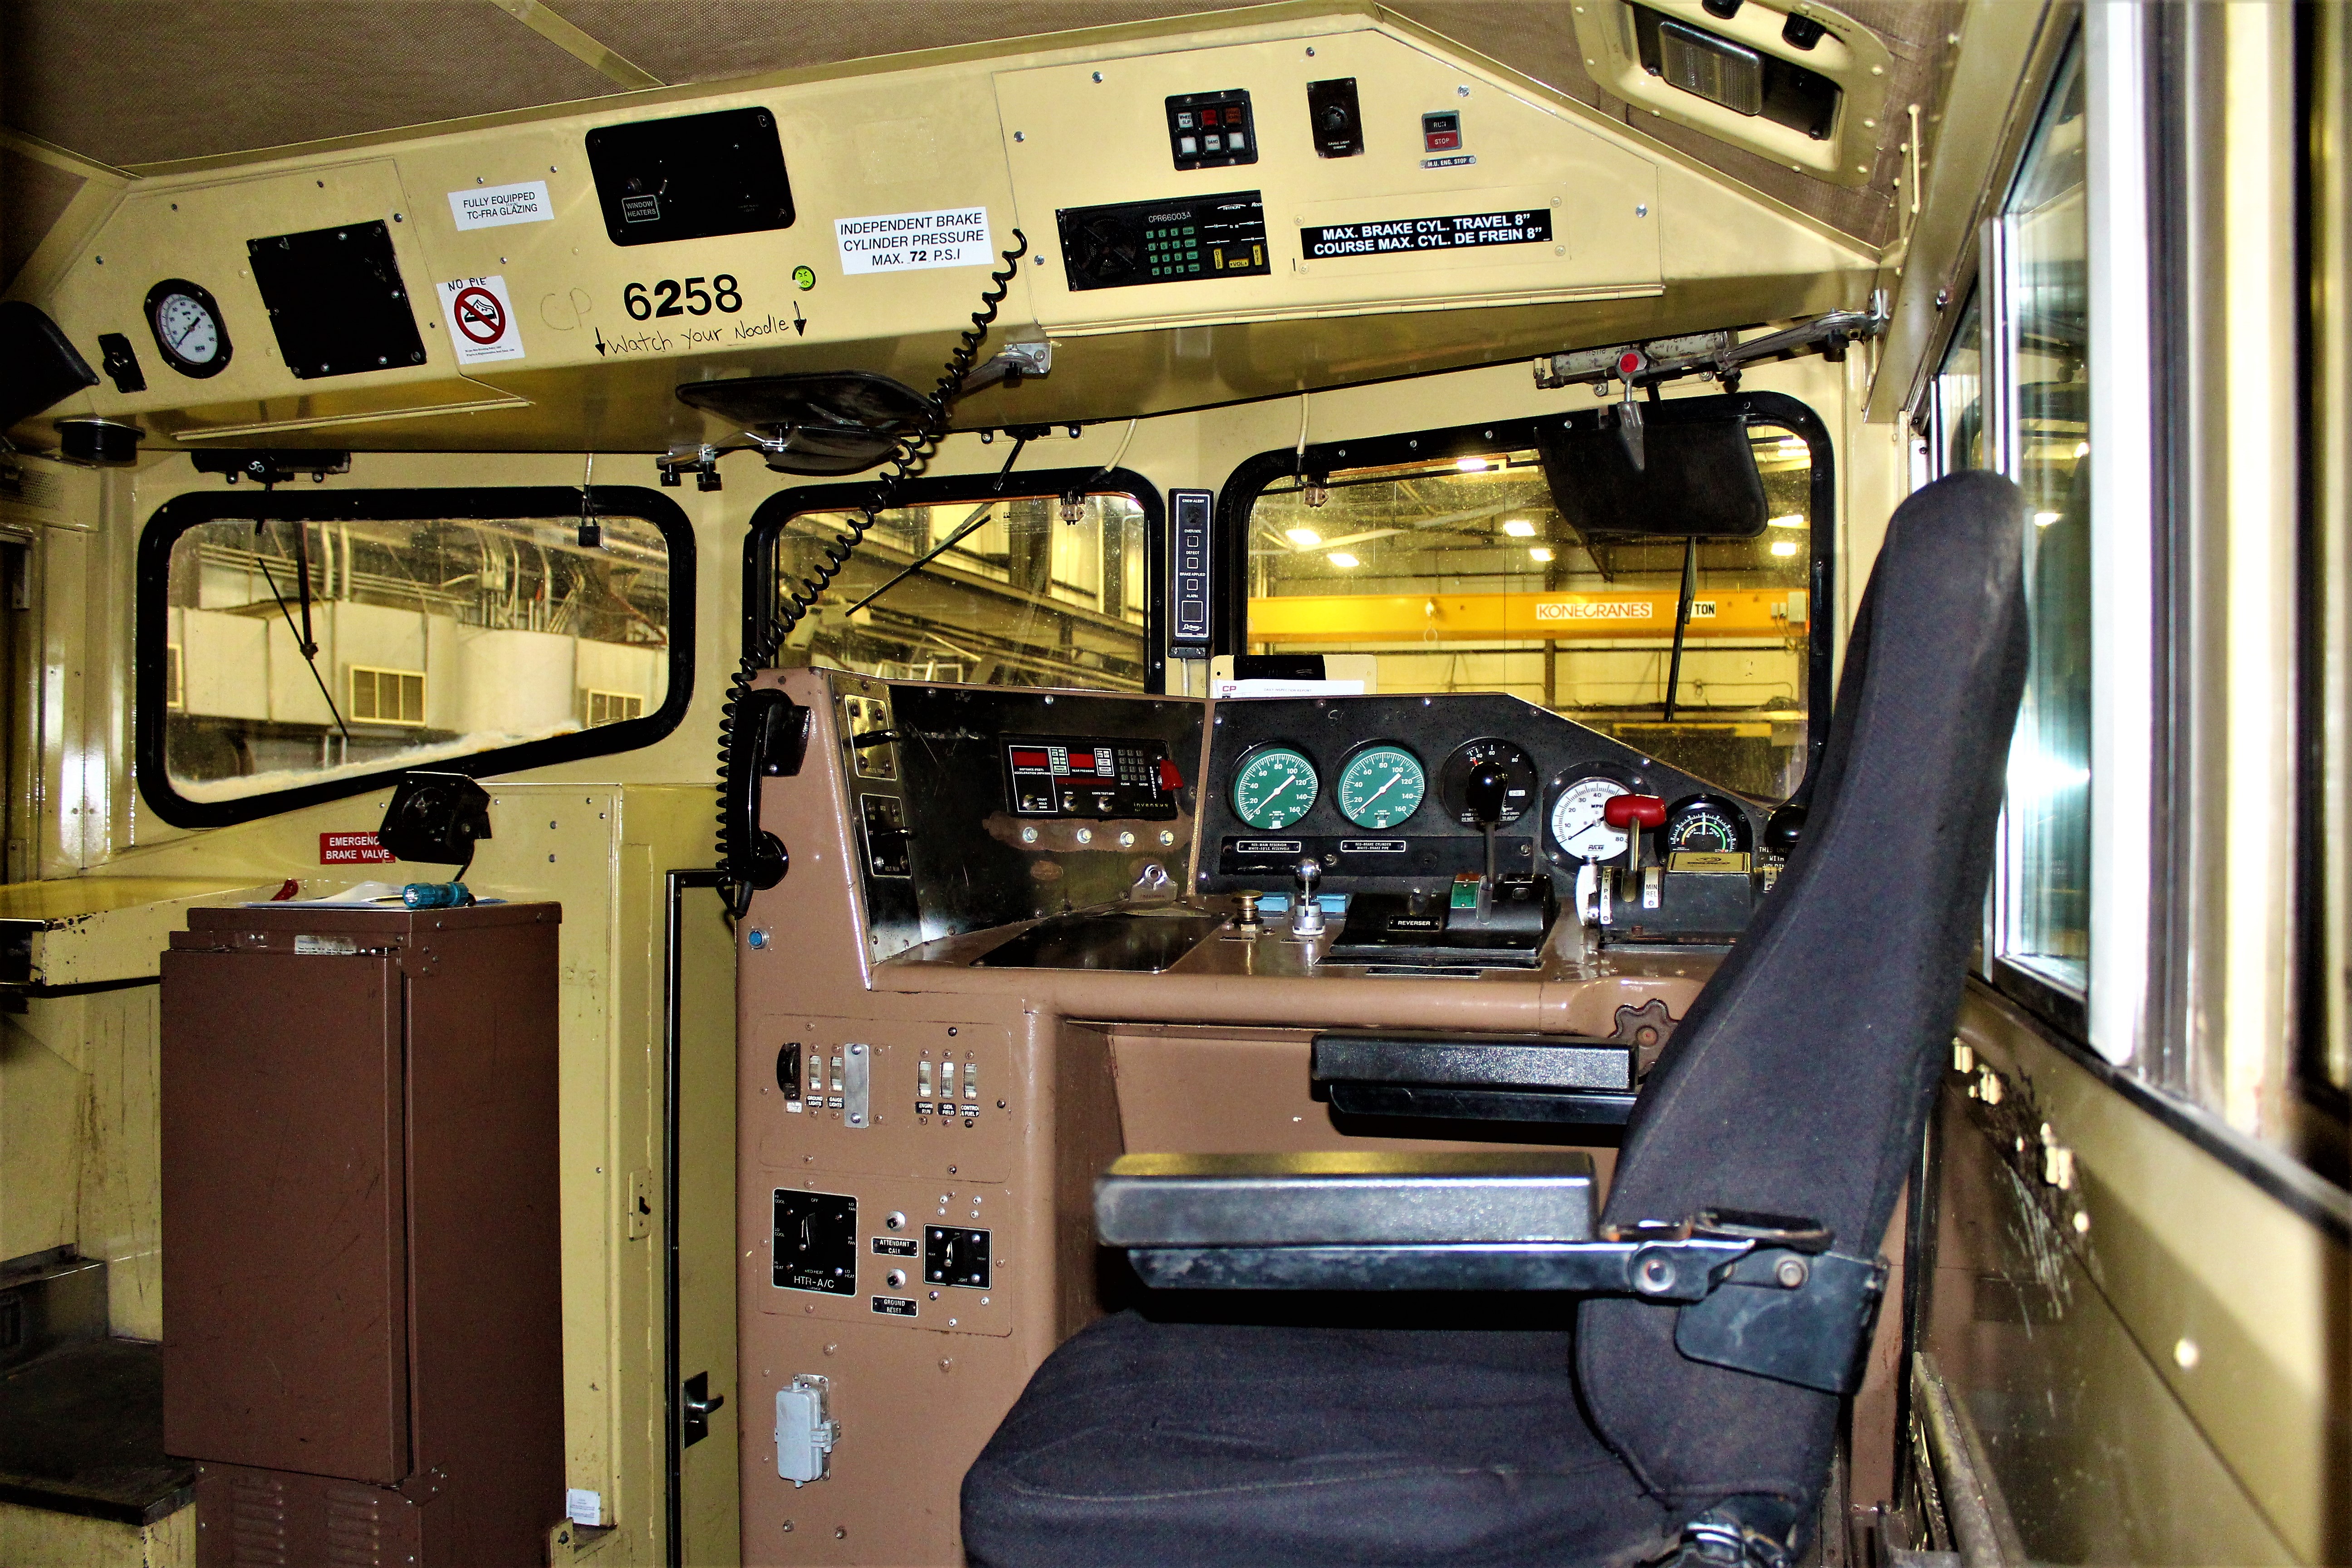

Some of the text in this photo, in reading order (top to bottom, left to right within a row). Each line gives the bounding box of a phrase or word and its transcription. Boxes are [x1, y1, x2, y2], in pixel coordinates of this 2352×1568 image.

[463, 197, 489, 208] FULLY
[491, 191, 535, 205] EQUIPPED
[626, 201, 653, 209] WINDOW
[467, 208, 498, 220] TC-FRA
[500, 204, 538, 216] GLAZING
[627, 208, 656, 217] HEATERS
[1148, 212, 1191, 223] CPR66003A
[840, 213, 982, 235] INDEPENDENT BRAKE
[1323, 228, 1358, 240] MAX.
[1362, 223, 1413, 237] BRAKE
[1417, 220, 1450, 233] CYL.
[1453, 216, 1513, 230] TRAVEL
[844, 230, 984, 251] CYLINDER PRESSURE
[1314, 240, 1375, 255] COURSE
[1378, 237, 1414, 250] MAX.
[1418, 234, 1451, 247] CYL.
[1455, 232, 1475, 244] DE
[1479, 228, 1523, 242] FREIN
[872, 249, 960, 266] MAX. 72 P.S.I
[448, 277, 486, 291] NO PIE
[623, 274, 743, 320] 6258
[607, 331, 673, 354] Watch
[735, 314, 789, 340] Noodle
[1539, 603, 1651, 618] KONECRANES
[1695, 603, 1715, 615] TON
[329, 836, 380, 846] EMERGENC
[326, 849, 390, 859] BRAKE VALVE
[794, 1275, 834, 1288] HTR-A/C
